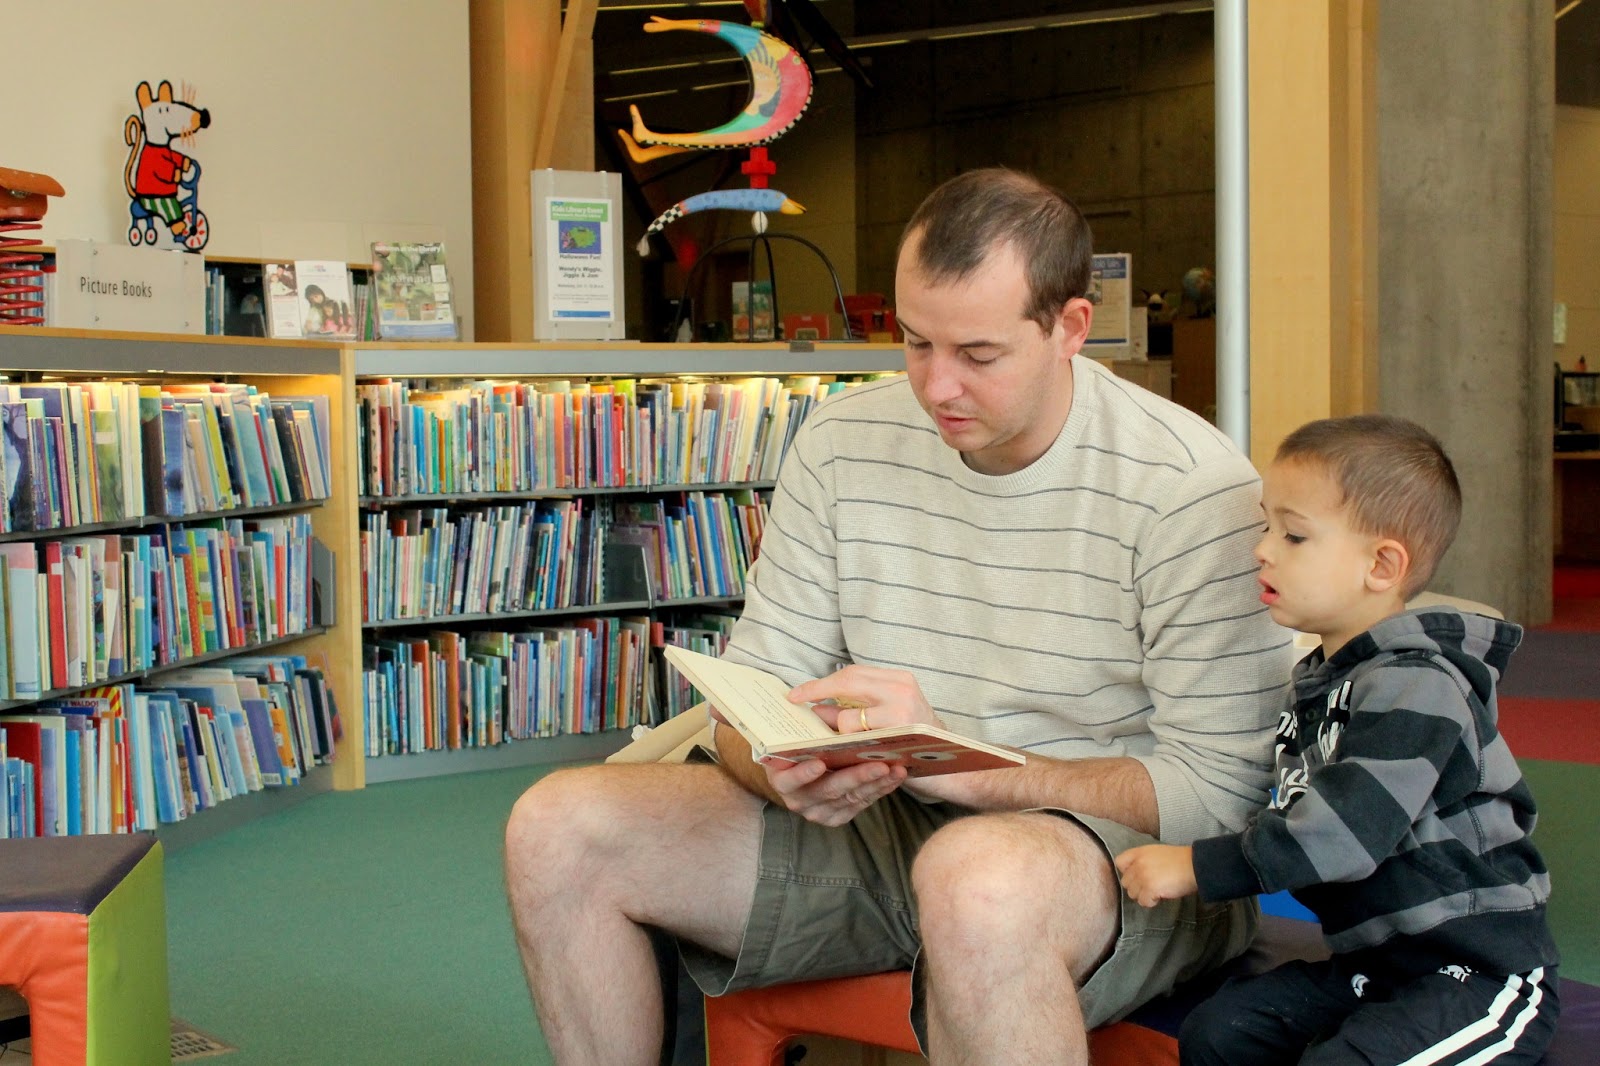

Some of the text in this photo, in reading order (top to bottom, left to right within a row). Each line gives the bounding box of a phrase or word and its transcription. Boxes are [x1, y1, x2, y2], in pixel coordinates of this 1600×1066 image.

[566, 206, 586, 214] Library
[80, 276, 153, 298] Picture Books
